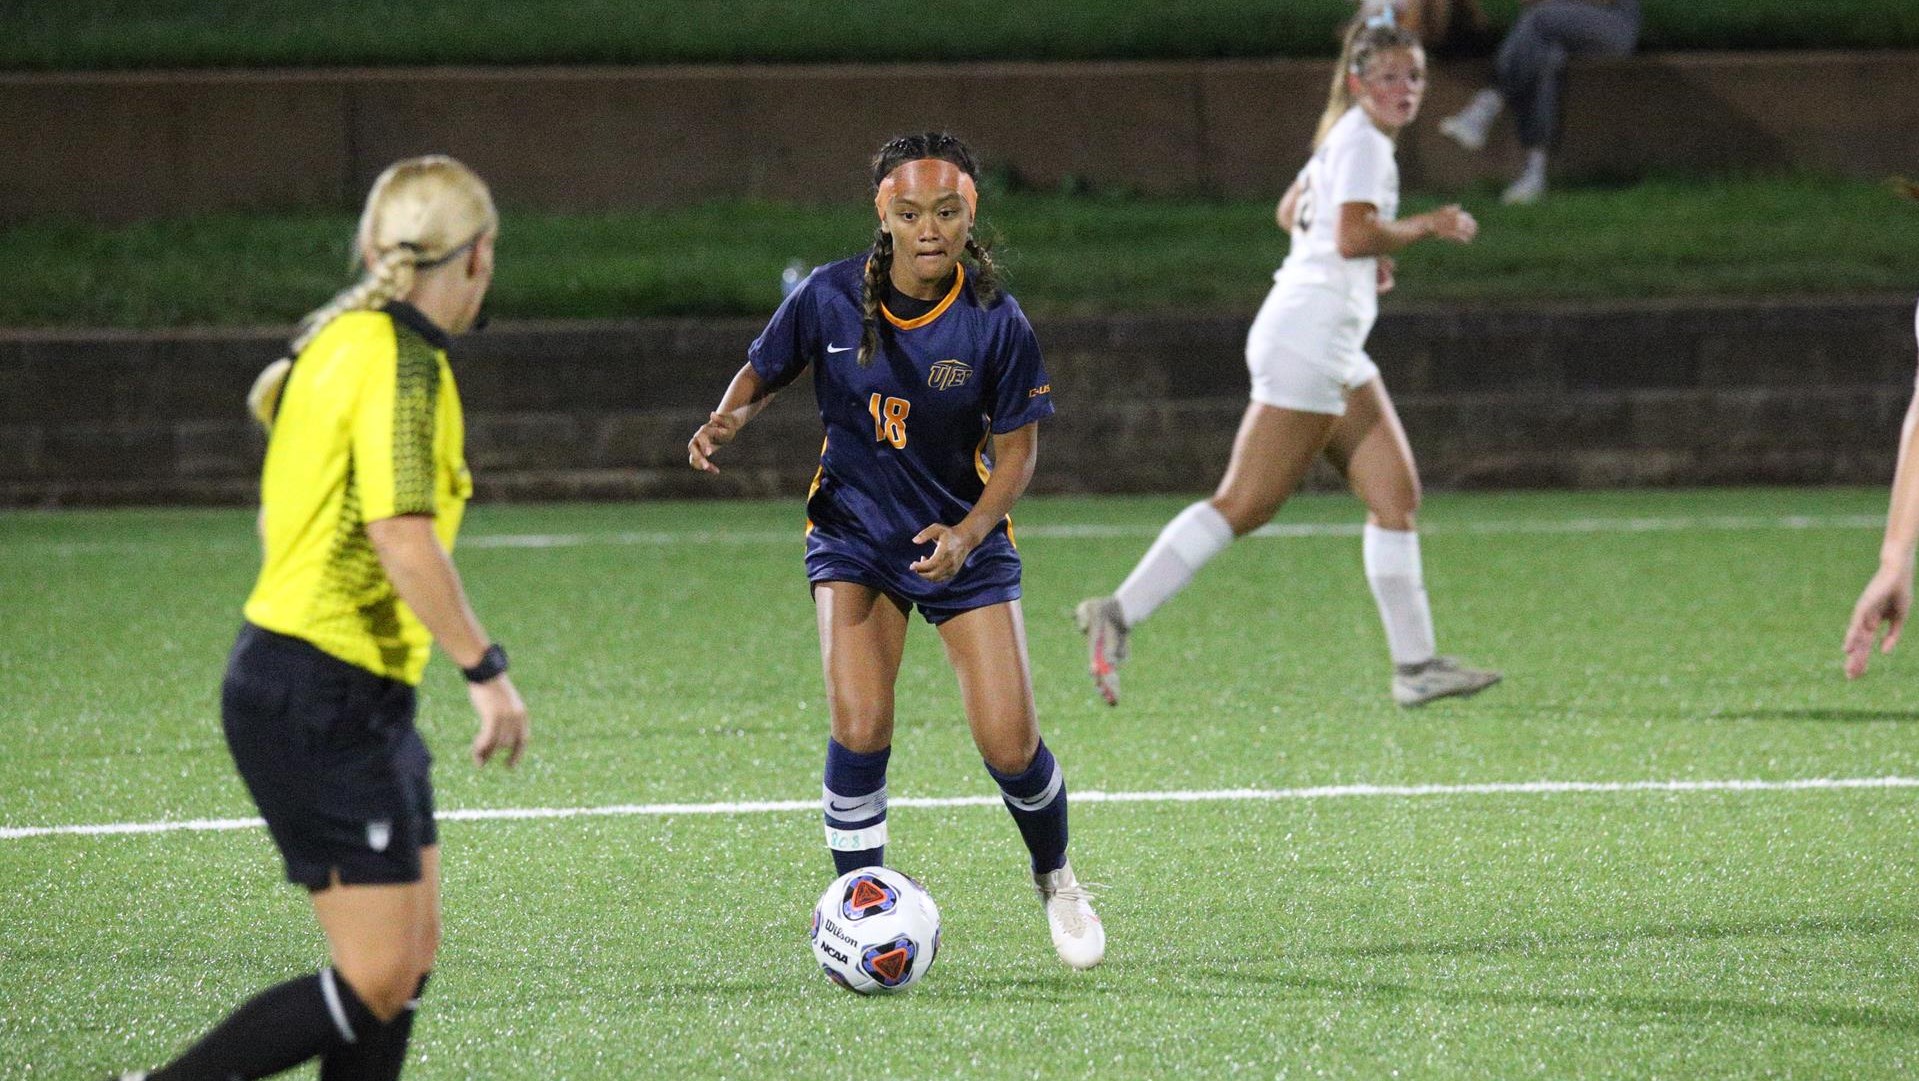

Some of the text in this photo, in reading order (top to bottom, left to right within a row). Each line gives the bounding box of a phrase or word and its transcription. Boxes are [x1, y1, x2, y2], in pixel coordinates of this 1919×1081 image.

[868, 393, 911, 449] 18
[825, 919, 858, 948] Wilson
[820, 940, 848, 965] NCAA
